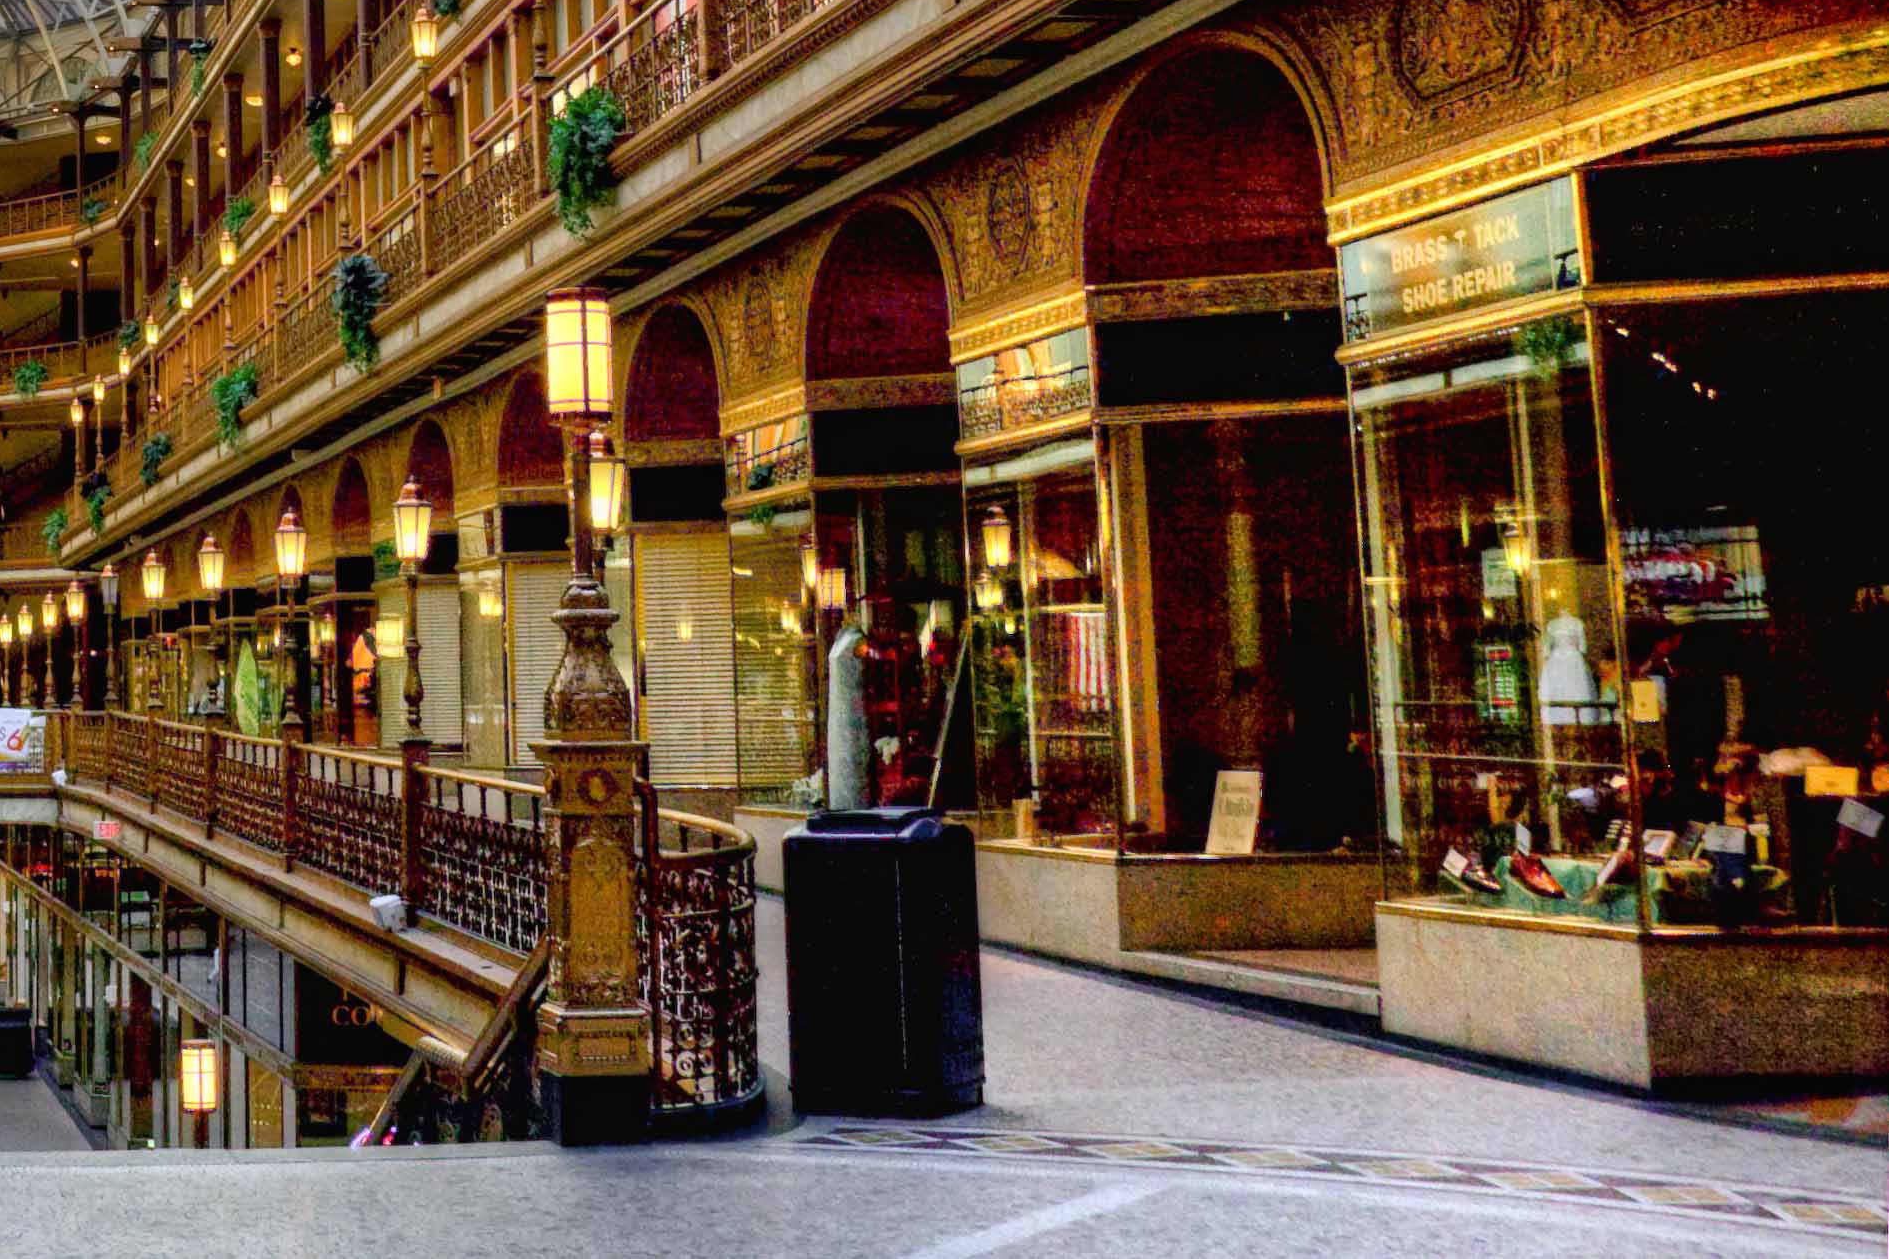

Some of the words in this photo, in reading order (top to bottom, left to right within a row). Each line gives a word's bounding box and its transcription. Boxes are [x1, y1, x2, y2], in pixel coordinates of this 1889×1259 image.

[1390, 235, 1448, 273] BRASS
[1472, 215, 1519, 249] TACK
[1401, 282, 1448, 314] SHOE
[1452, 261, 1516, 299] REPAIR
